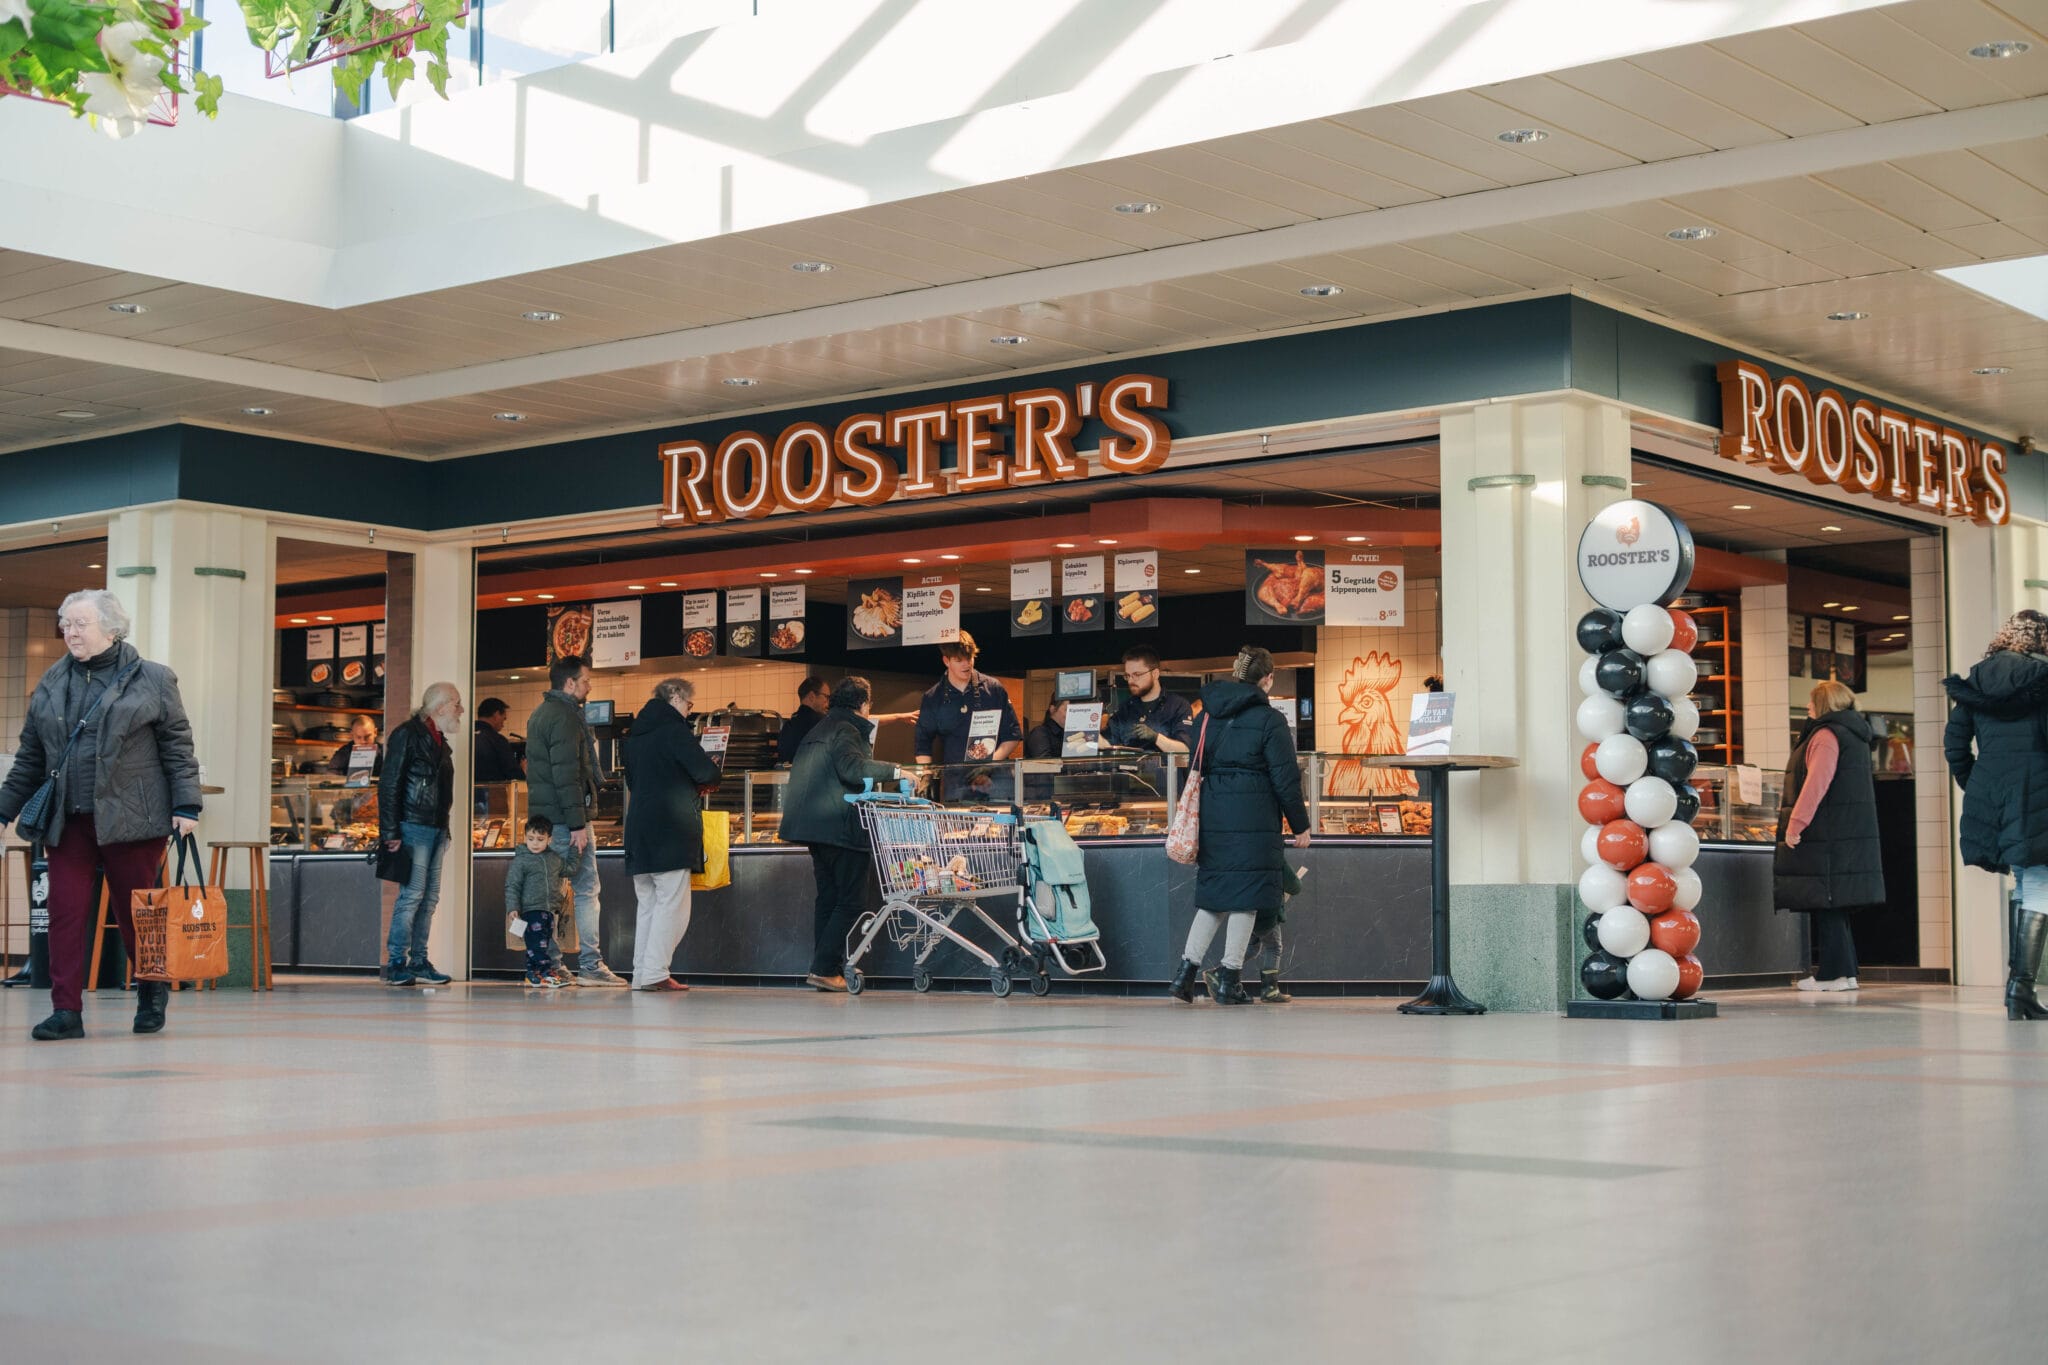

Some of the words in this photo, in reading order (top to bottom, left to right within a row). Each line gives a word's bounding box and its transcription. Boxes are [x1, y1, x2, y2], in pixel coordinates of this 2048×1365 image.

[1716, 359, 2010, 528] ROOSTER'S
[656, 373, 1171, 527] ROOSTER'S
[1350, 554, 1380, 562] ACTIE!
[1587, 549, 1670, 567] ROOSTER'S
[1332, 569, 1341, 584] 5
[1343, 576, 1375, 586] Gegrilde
[906, 590, 928, 600] Kipfilet
[929, 589, 935, 597] in
[1330, 585, 1377, 595] kippenpoten
[906, 608, 944, 618] aardappeltjes
[1379, 609, 1397, 621] 8.95
[1432, 708, 1449, 716] VAN
